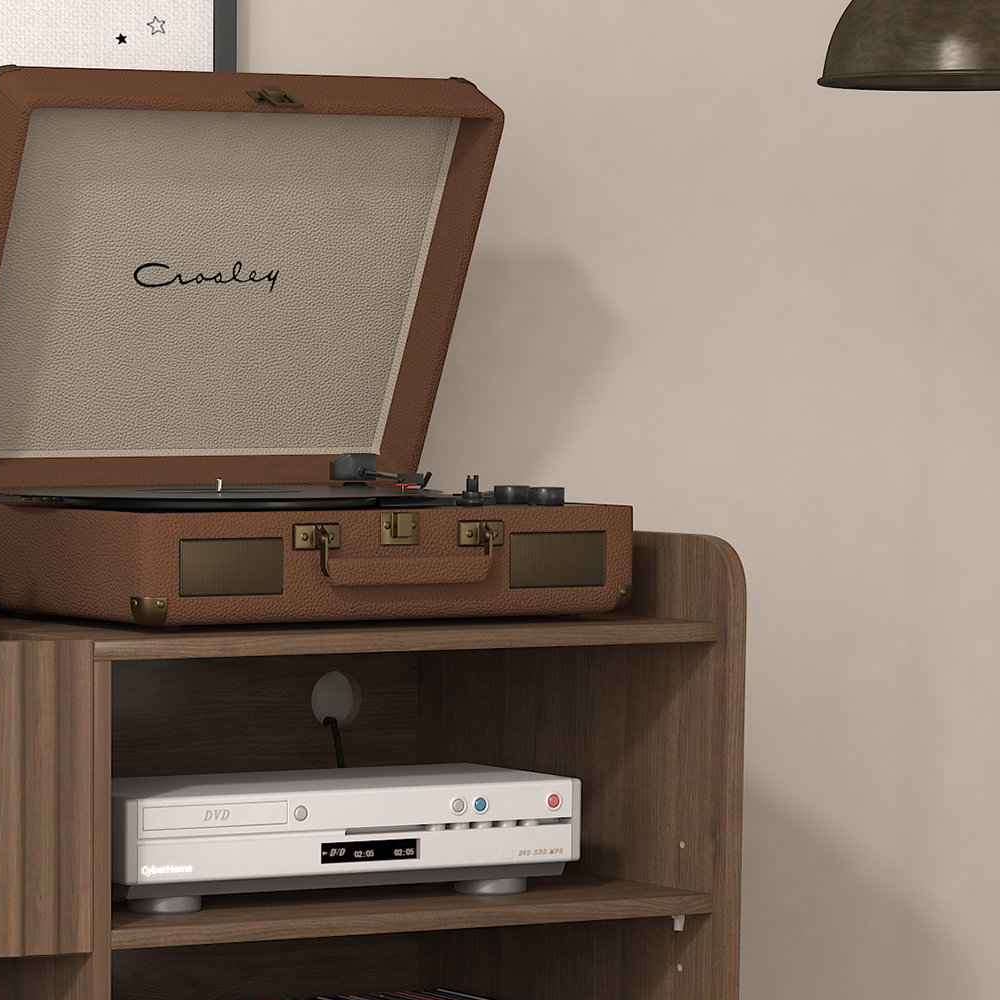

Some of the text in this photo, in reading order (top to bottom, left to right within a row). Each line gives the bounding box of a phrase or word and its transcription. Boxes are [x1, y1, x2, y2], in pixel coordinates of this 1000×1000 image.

[133, 260, 280, 293] Crosley
[203, 809, 231, 822] DVD
[353, 850, 375, 858] 02:05
[393, 848, 415, 857] 02:05
[141, 865, 193, 877] CyberHome
